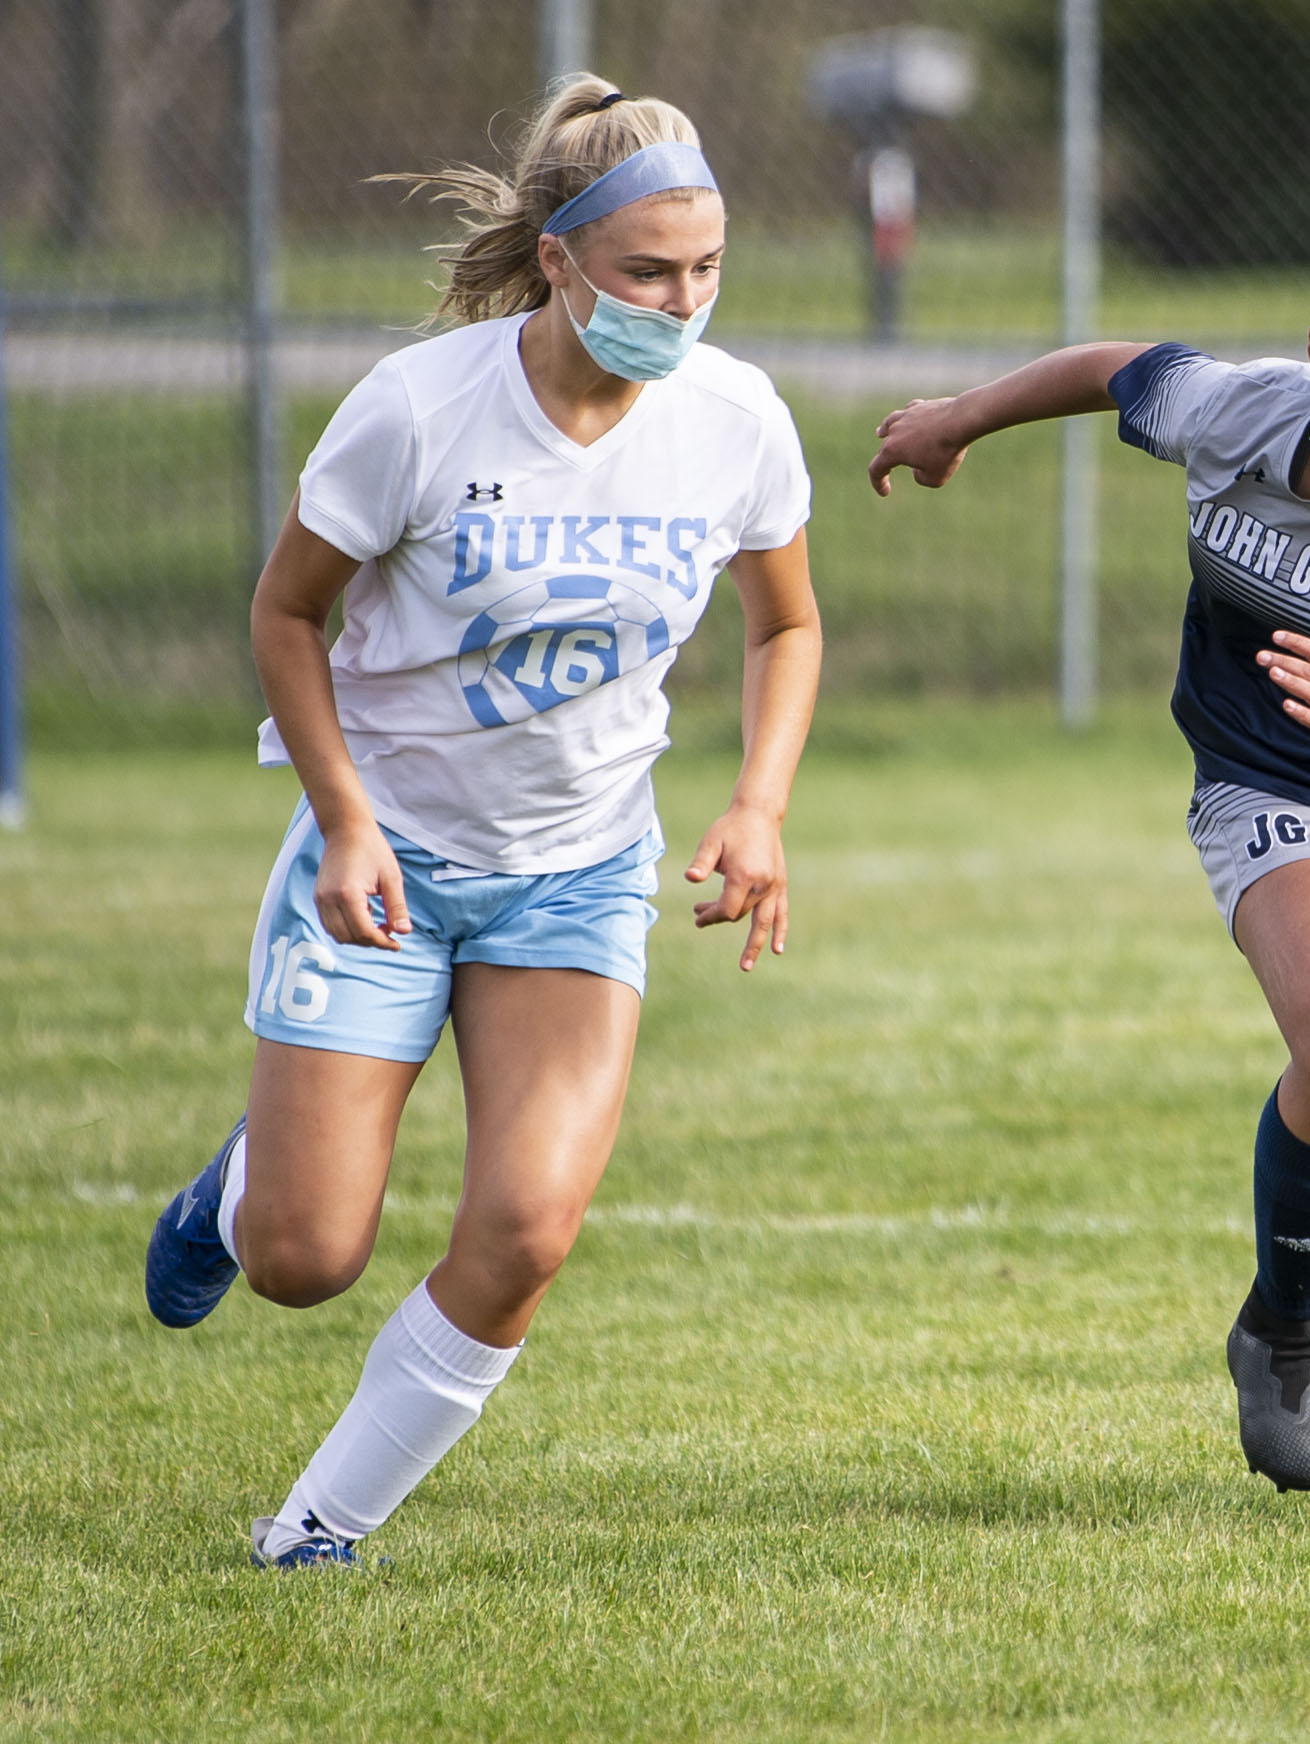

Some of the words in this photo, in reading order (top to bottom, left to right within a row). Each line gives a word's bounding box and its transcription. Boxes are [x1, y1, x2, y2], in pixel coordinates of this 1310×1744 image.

[447, 512, 707, 601] DUKES
[1189, 501, 1293, 582] JOHN
[514, 629, 613, 696] 16
[1245, 812, 1307, 860] JG
[261, 936, 336, 1022] 16
